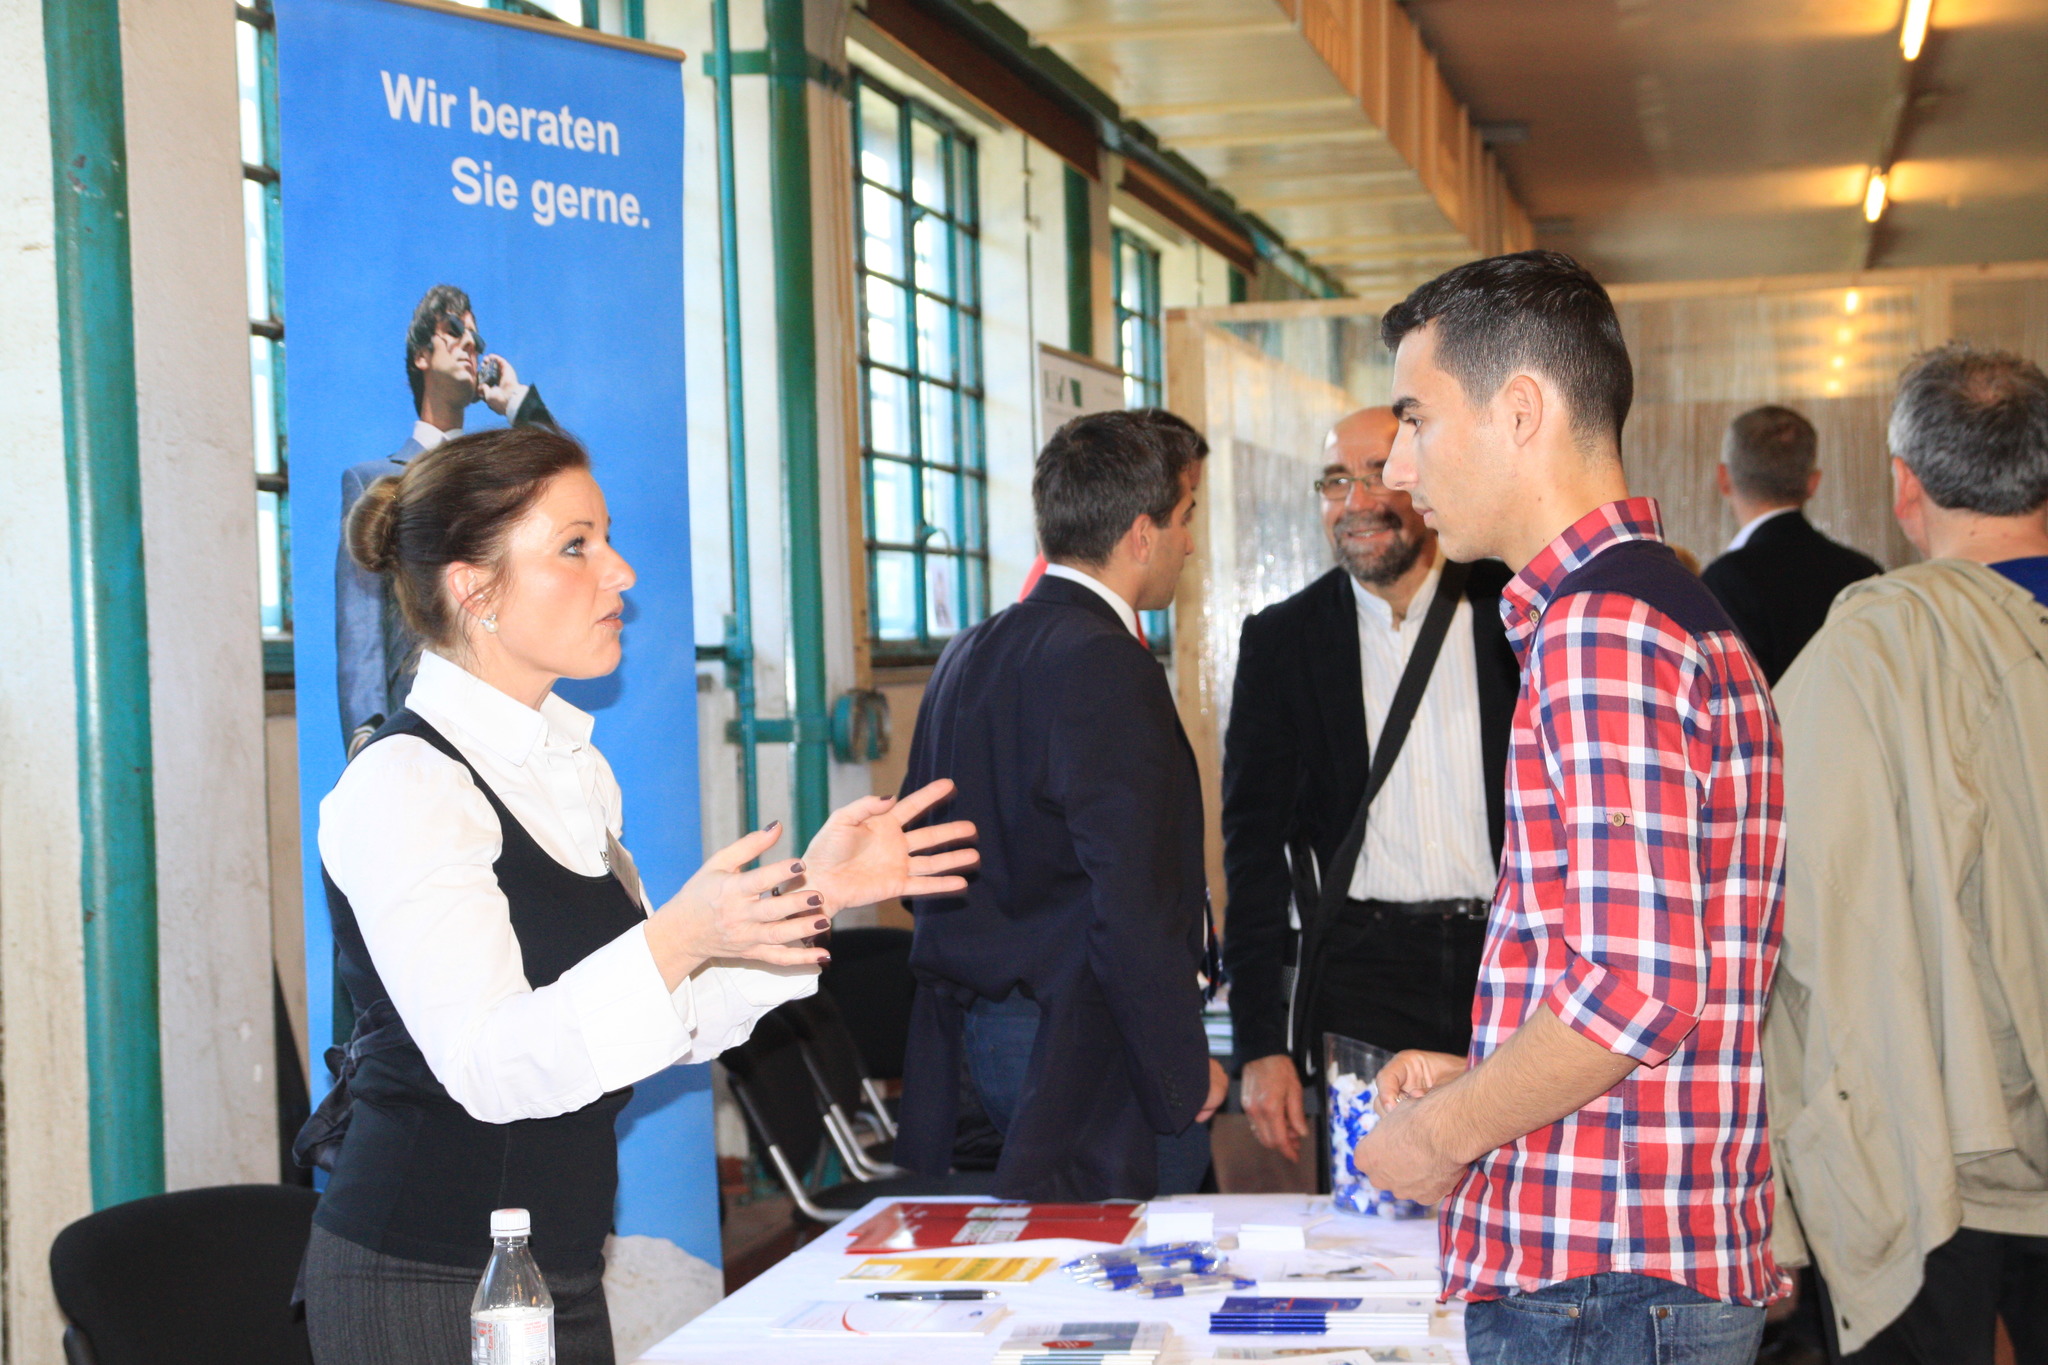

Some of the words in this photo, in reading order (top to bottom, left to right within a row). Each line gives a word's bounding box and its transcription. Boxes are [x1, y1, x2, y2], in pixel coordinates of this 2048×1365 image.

[380, 69, 457, 129] Wir
[470, 86, 620, 157] beraten
[451, 156, 519, 210] Sie
[531, 179, 651, 229] gerne.
